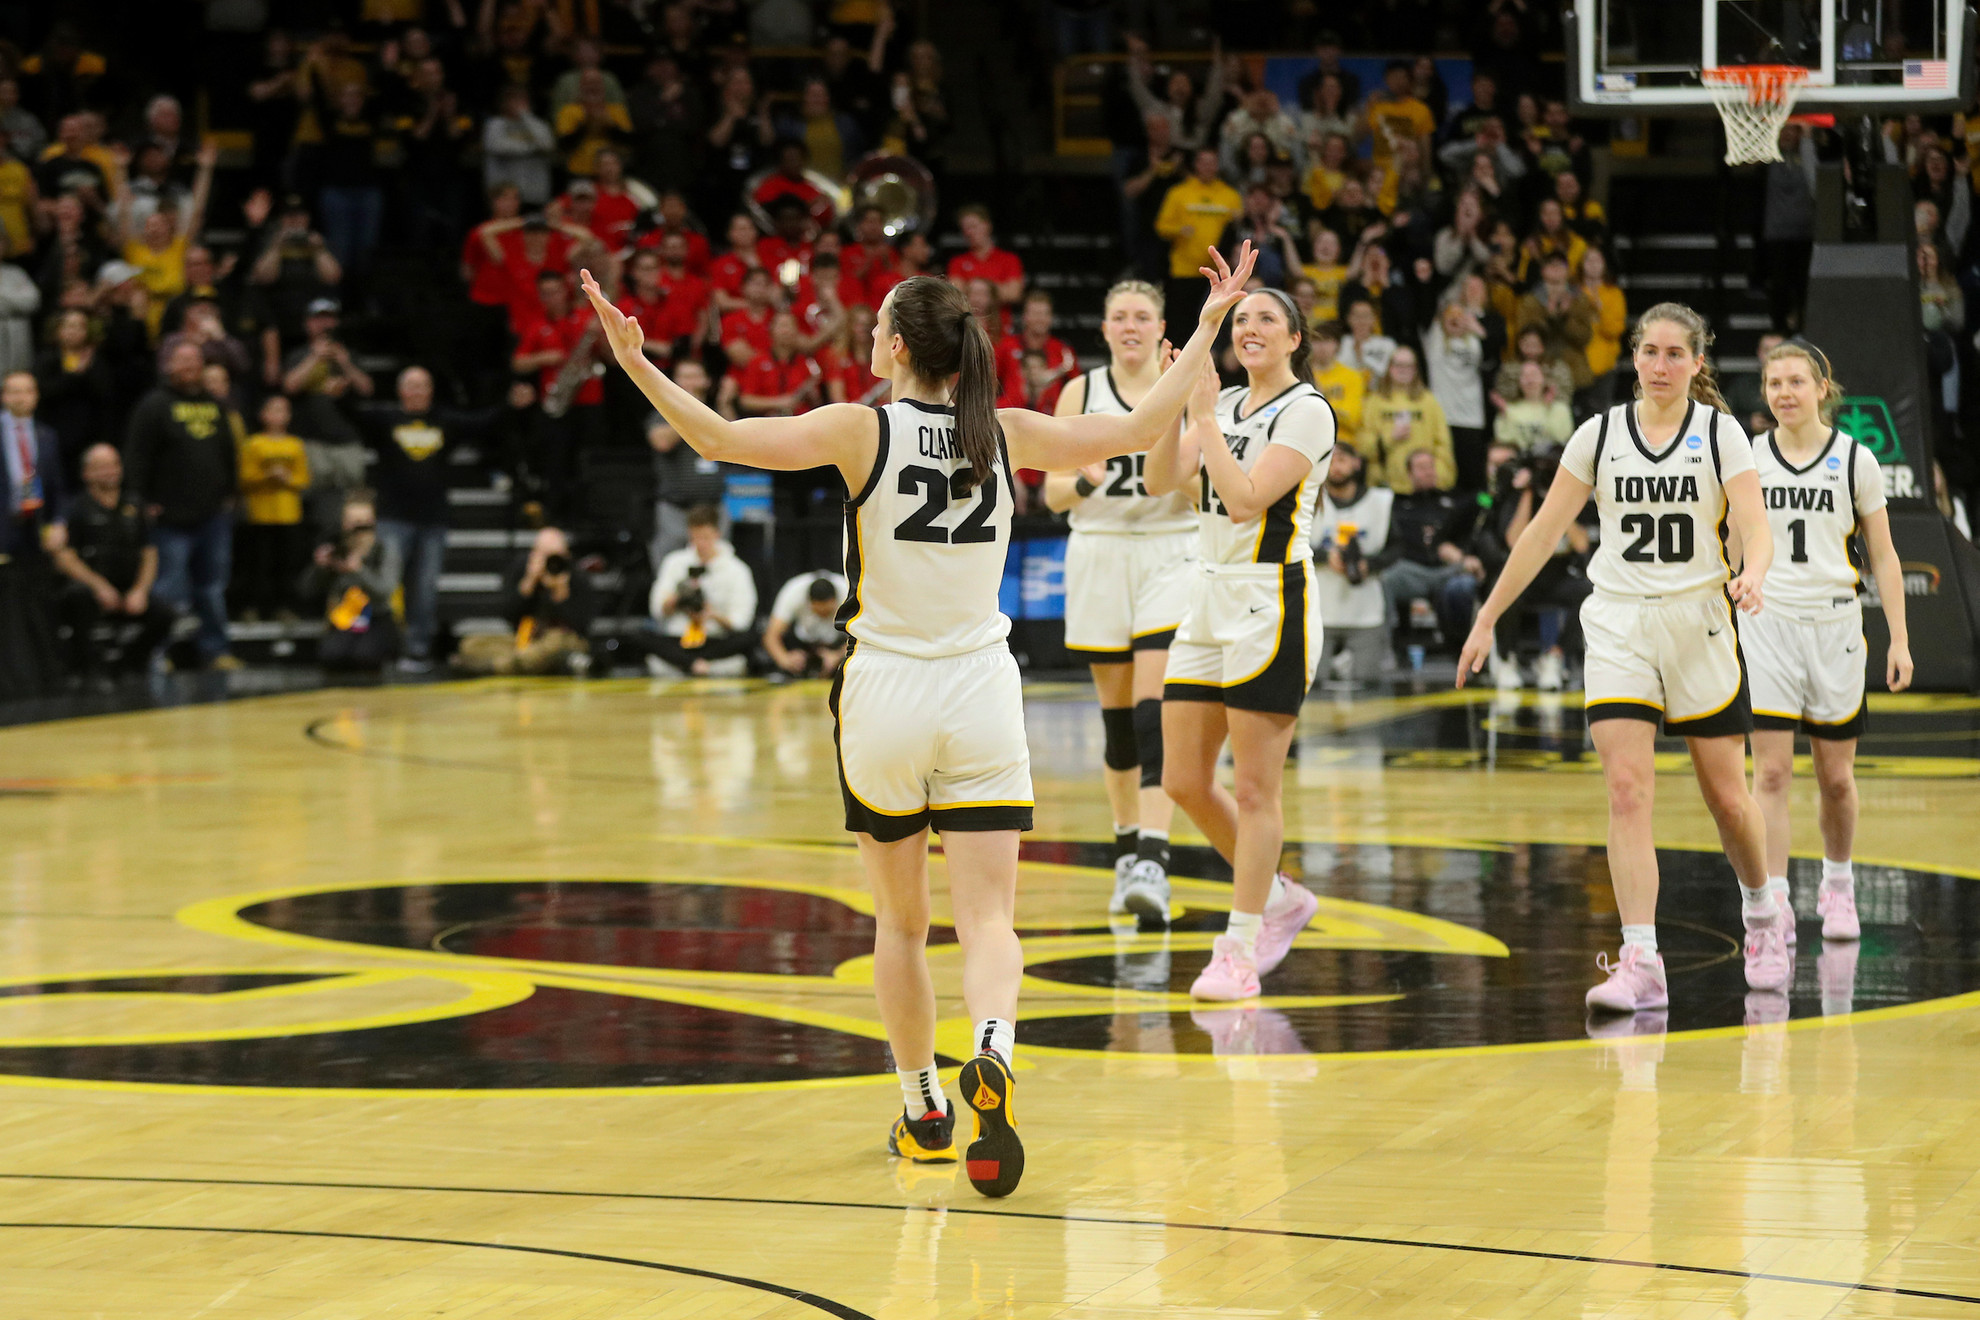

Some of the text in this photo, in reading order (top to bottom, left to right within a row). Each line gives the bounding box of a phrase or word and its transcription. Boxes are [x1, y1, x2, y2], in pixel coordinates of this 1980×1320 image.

[919, 425, 965, 460] CLAR
[894, 464, 998, 544] 22
[1615, 476, 1699, 503] IOWA
[1621, 513, 1694, 563] 20
[1787, 519, 1809, 563] 1
